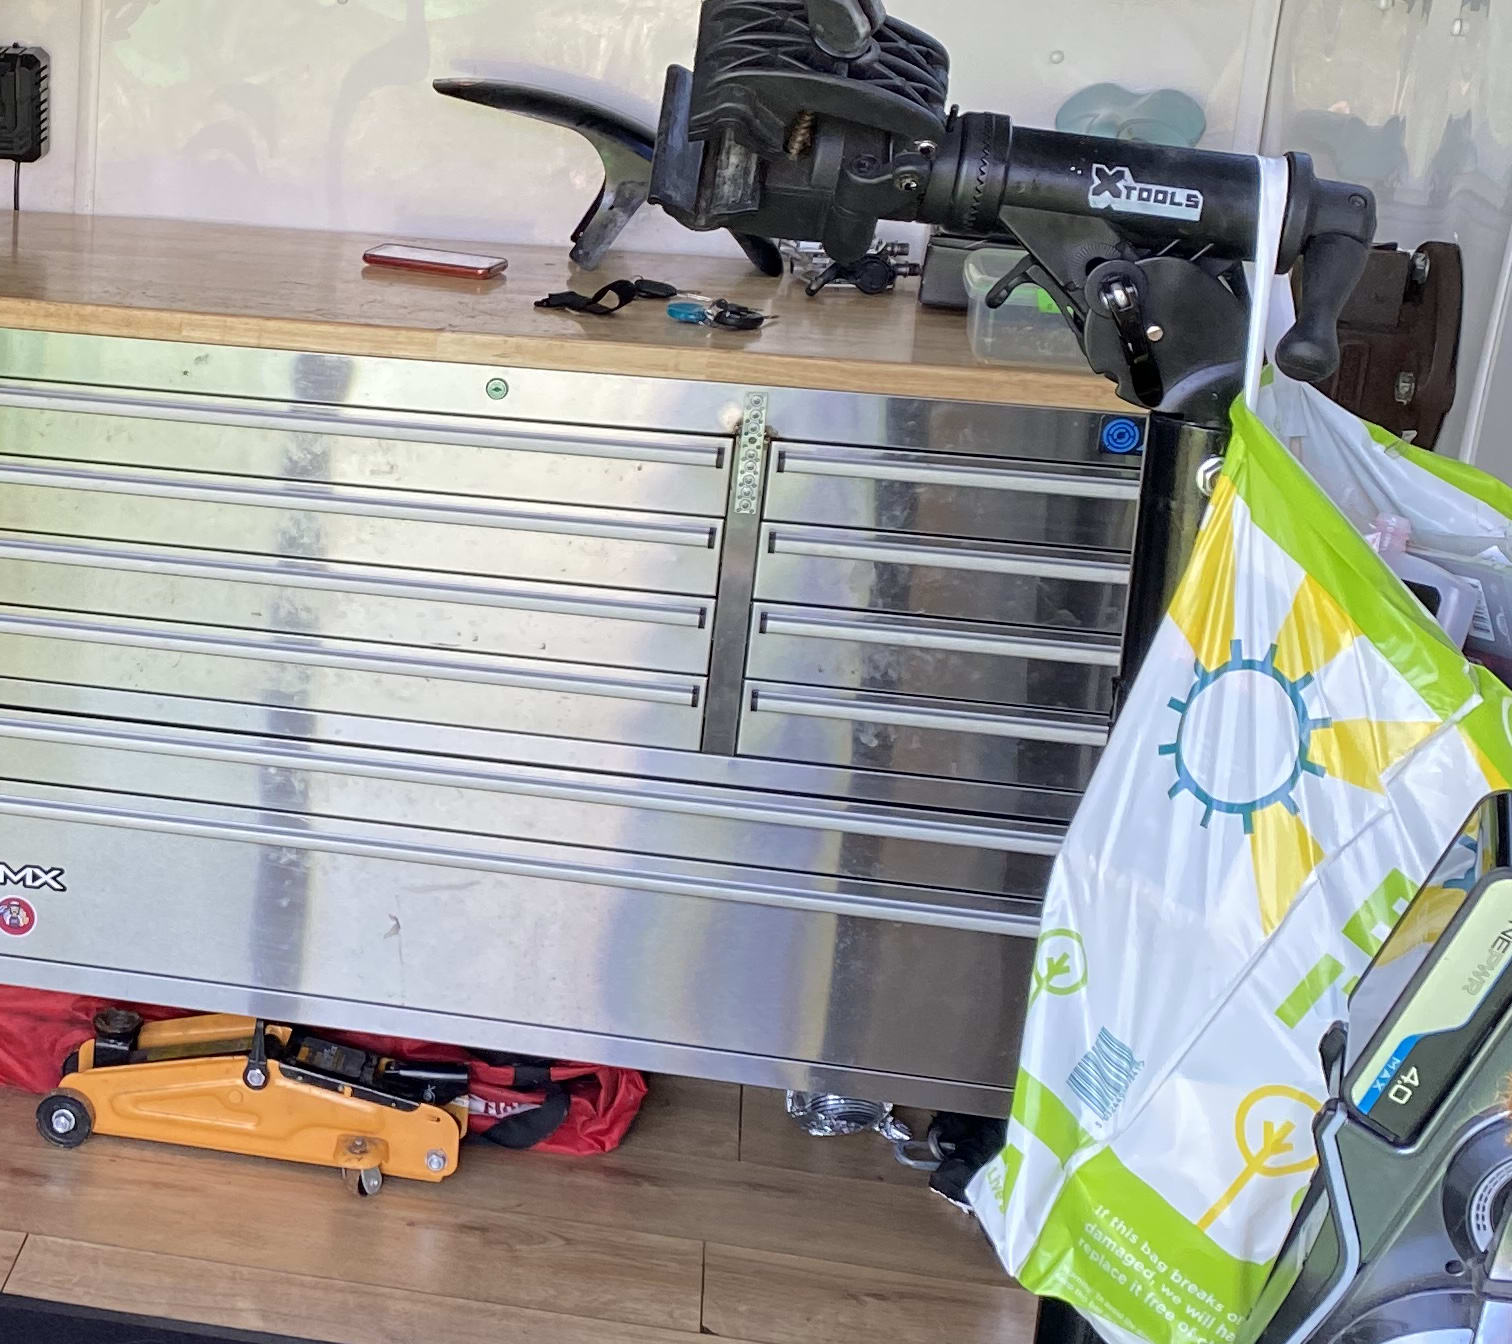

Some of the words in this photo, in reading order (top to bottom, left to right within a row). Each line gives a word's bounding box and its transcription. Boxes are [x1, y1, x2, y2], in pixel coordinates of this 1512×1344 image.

[1371, 1055, 1401, 1093] MAX
[1388, 1064, 1421, 1106] 4.0
[1079, 1236, 1127, 1286] replace
[1130, 1280, 1143, 1297] it
[1144, 1291, 1176, 1322] free
[1084, 1222, 1156, 1286] damaged,
[1161, 1285, 1182, 1306] we
[1185, 1302, 1215, 1330] will
[1110, 1210, 1138, 1245] this
[1141, 1242, 1169, 1273] bag
[1170, 1268, 1225, 1313] breaks
